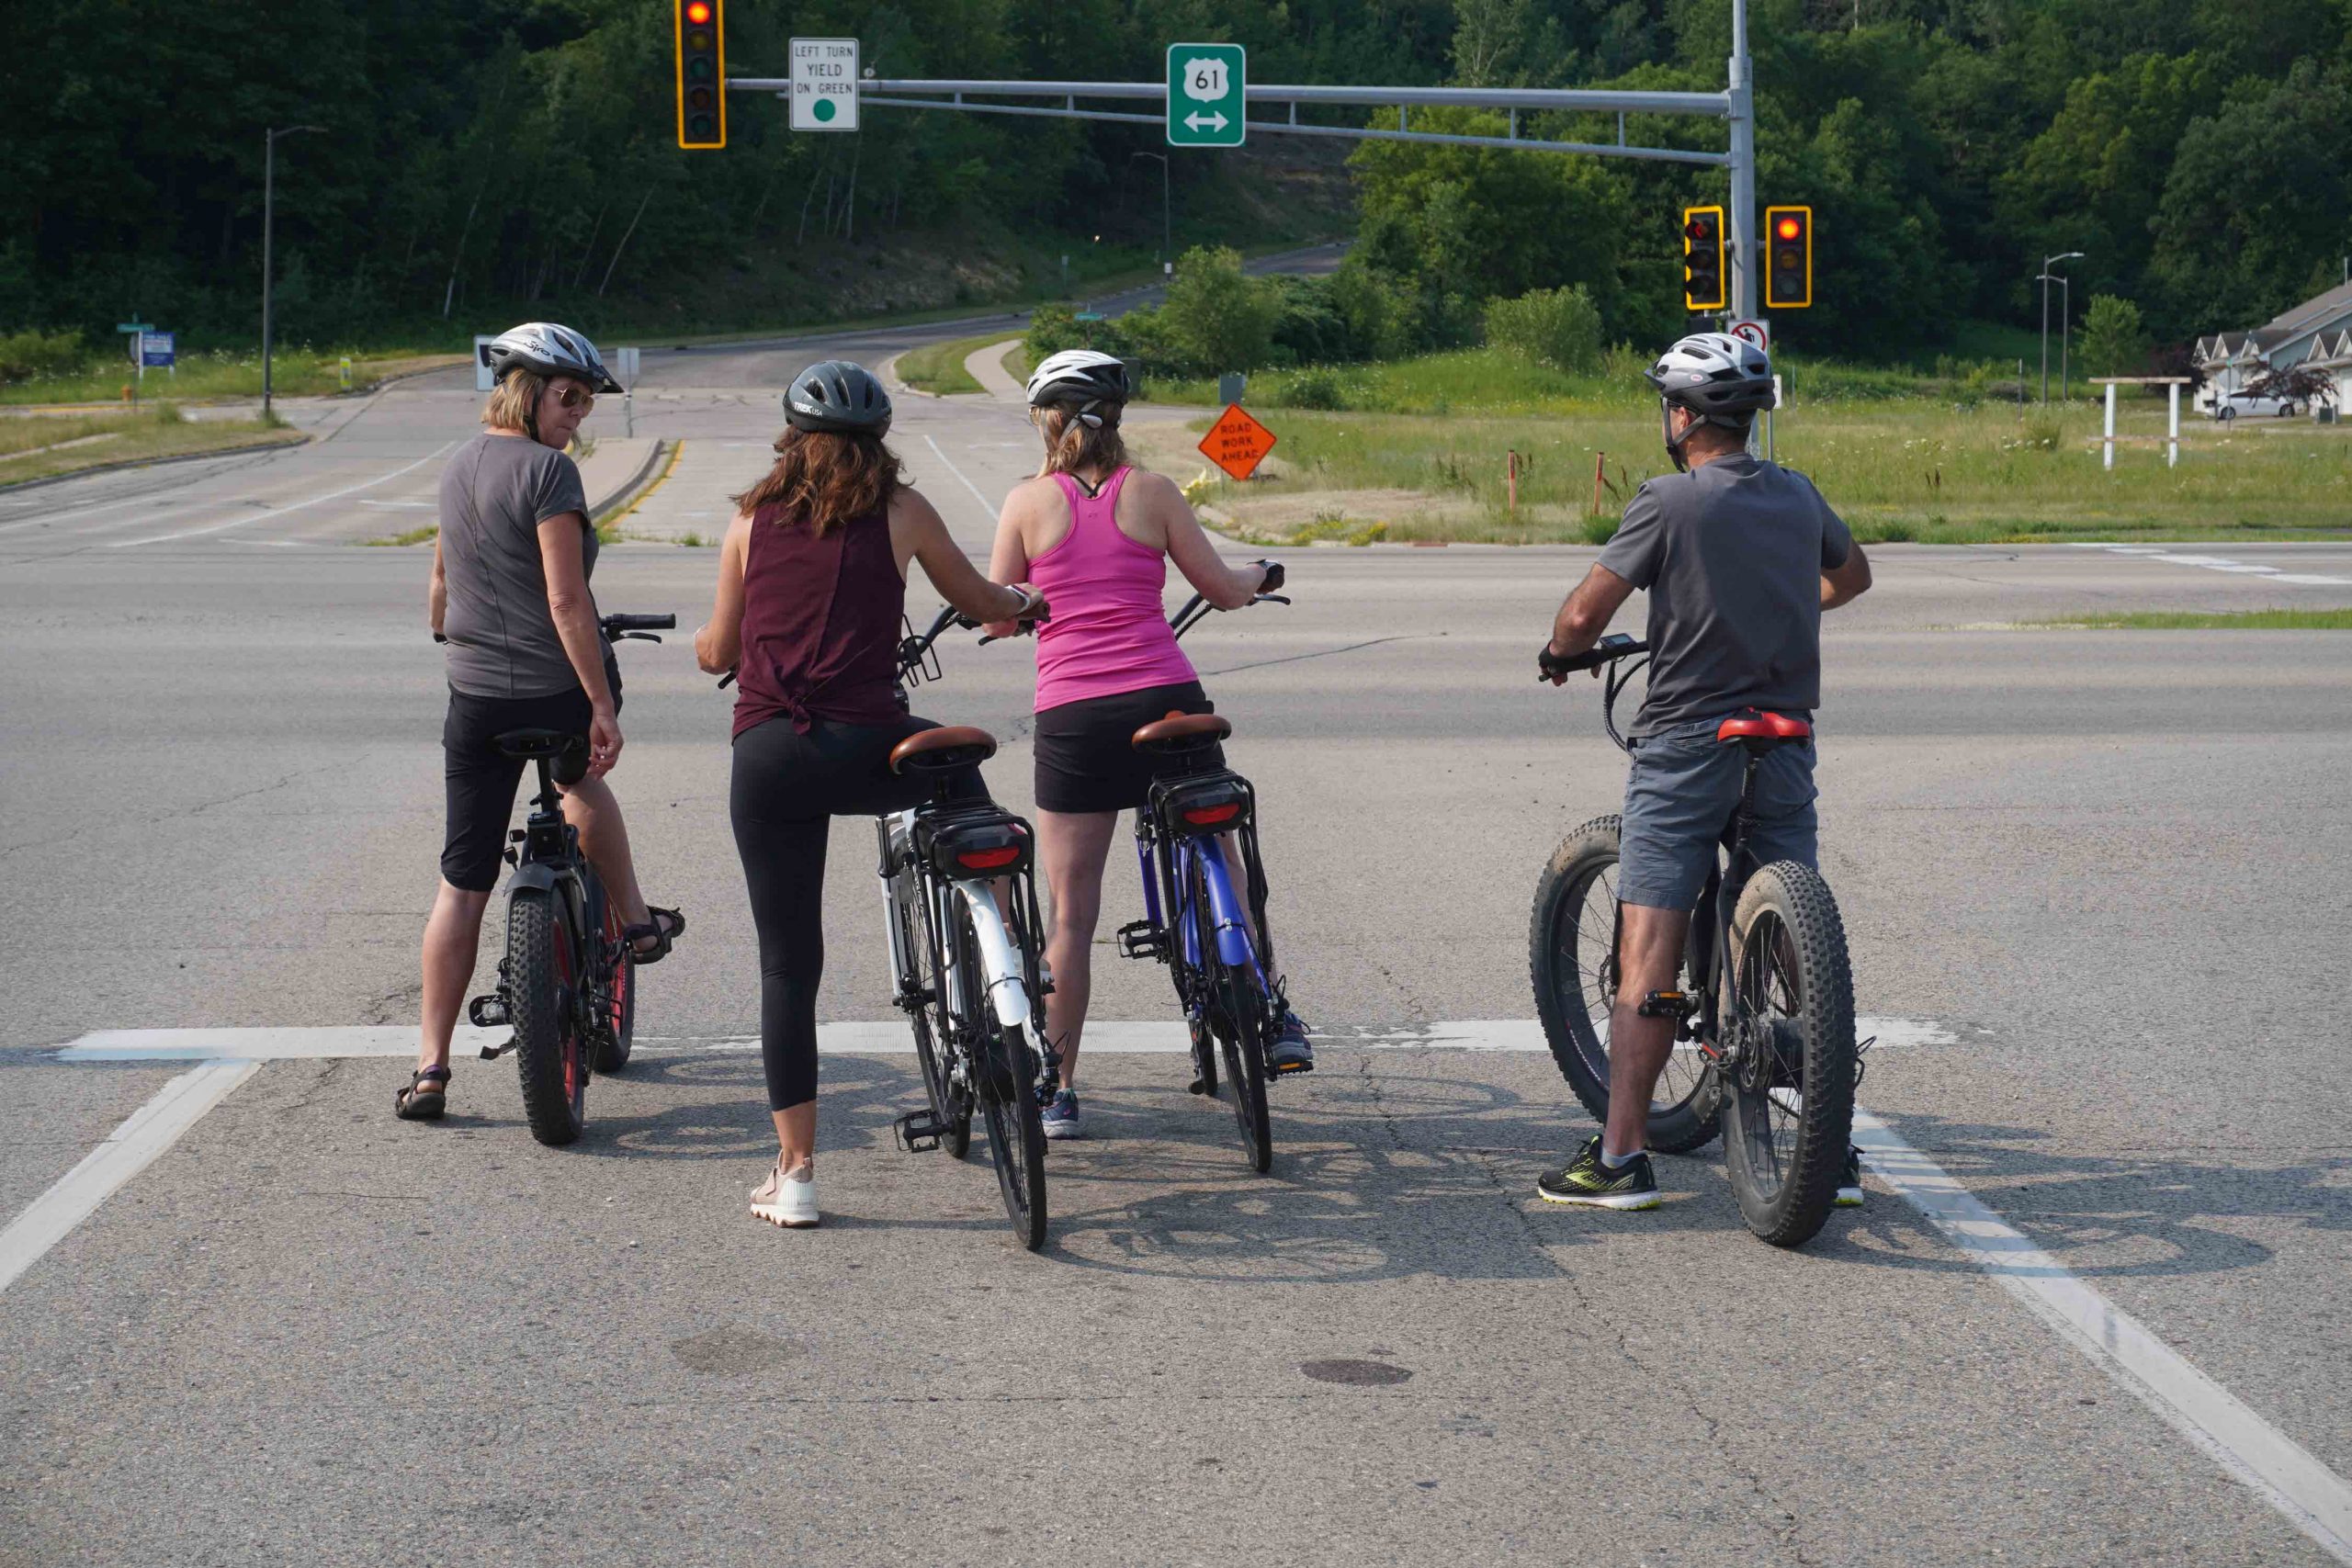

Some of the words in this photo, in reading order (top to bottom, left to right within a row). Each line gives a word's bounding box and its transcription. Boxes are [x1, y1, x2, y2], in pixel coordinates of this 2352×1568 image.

[794, 46, 820, 57] LEFT
[826, 46, 854, 57] TURN
[807, 63, 842, 76] YIELD
[1195, 69, 1217, 89] 61
[797, 83, 810, 95] ON
[818, 83, 853, 95] GREEN
[794, 400, 813, 414] TREK
[811, 408, 823, 417] USA
[1219, 423, 1252, 434] ROAD
[1220, 436, 1253, 448] WORK
